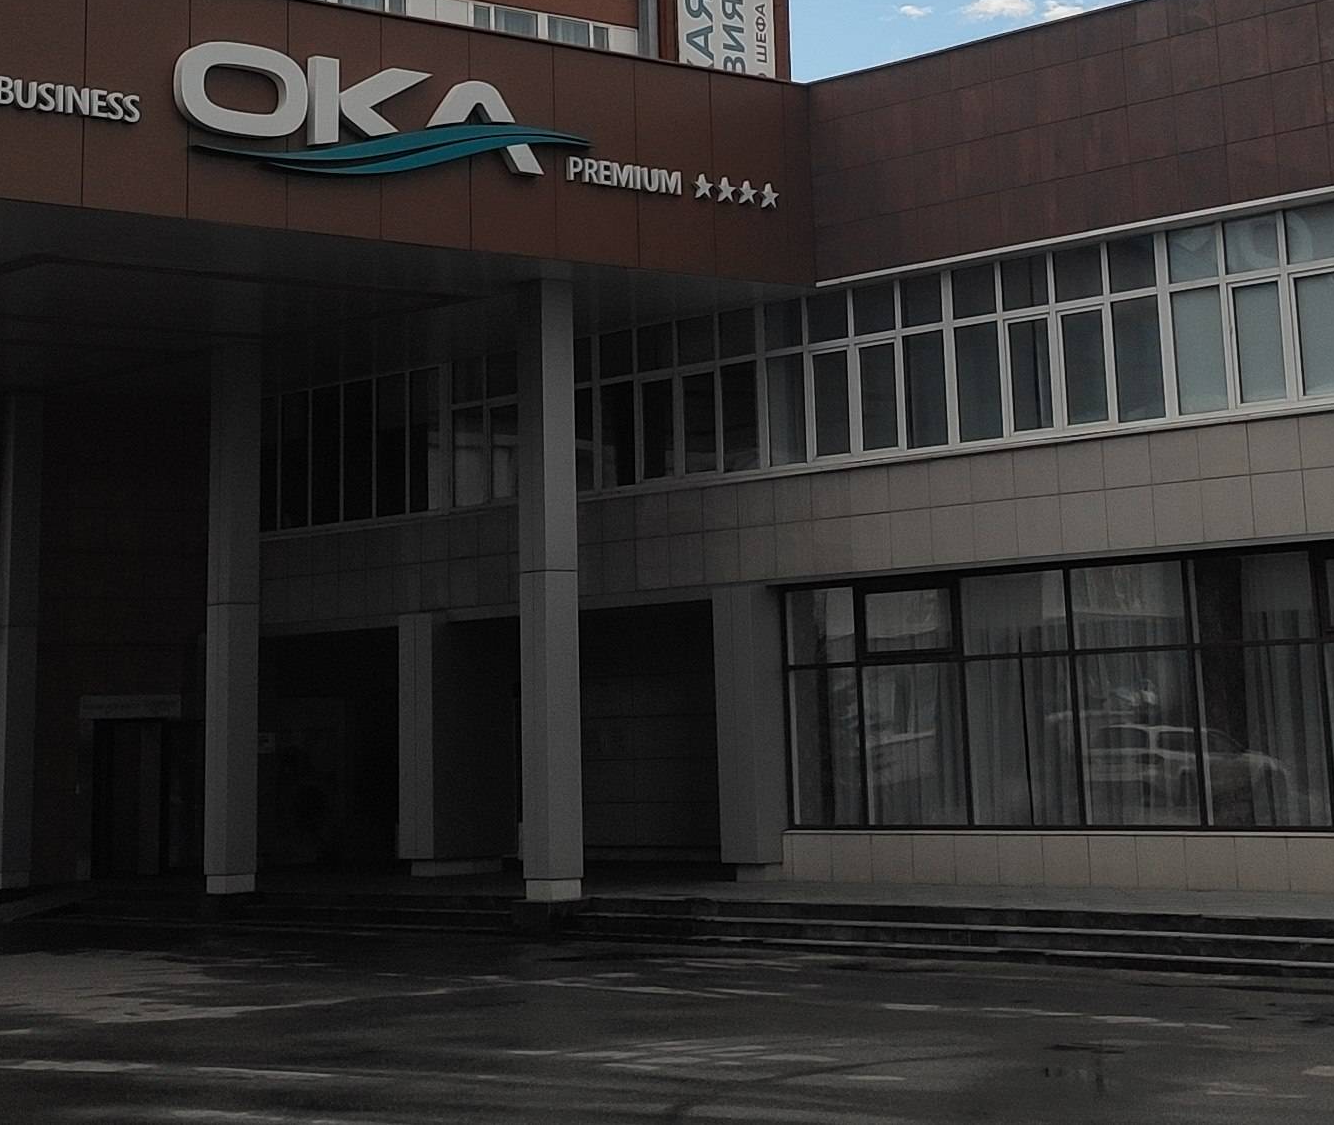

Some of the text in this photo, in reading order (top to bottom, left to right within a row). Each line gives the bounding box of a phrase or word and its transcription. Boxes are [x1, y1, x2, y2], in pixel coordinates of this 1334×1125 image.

[754, 3, 768, 64] ШЕФА
[173, 41, 545, 176] OKA
[567, 155, 682, 196] PREMIUM
